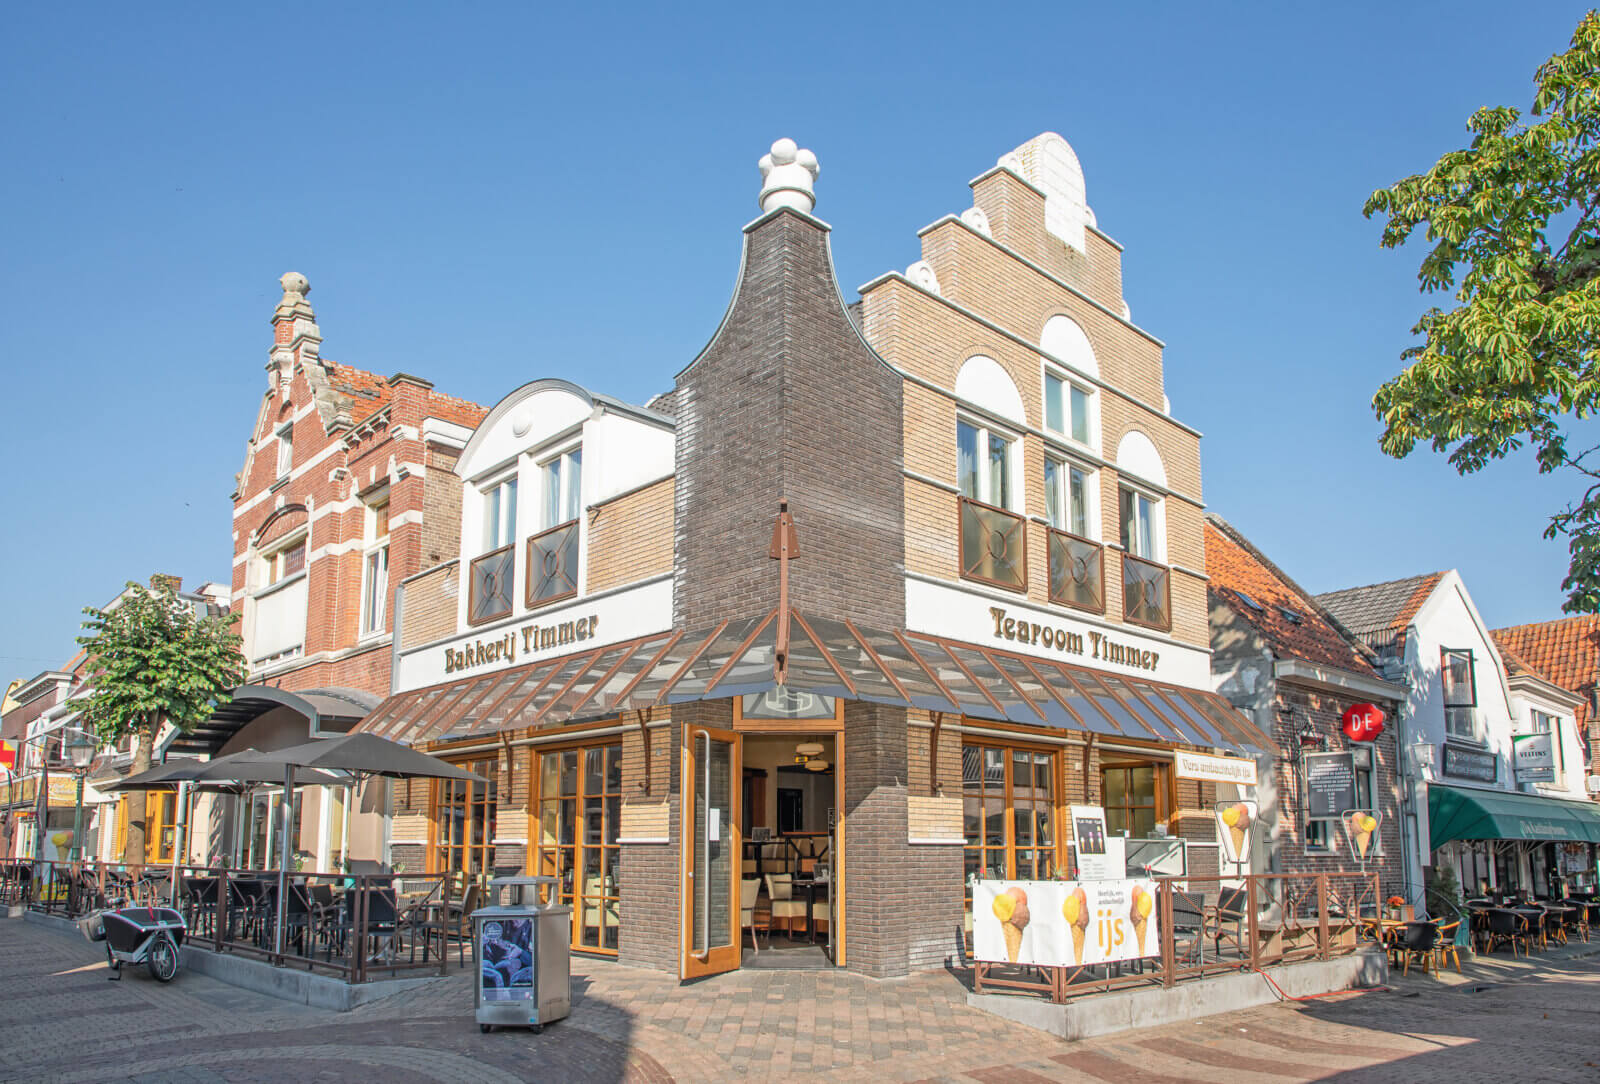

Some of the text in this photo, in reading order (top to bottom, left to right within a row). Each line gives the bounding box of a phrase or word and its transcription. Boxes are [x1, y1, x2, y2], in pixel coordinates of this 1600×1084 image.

[445, 614, 599, 674] Bakkerij Timmer
[989, 606, 1160, 671] Tearoom Timmer
[1097, 909, 1124, 957] ijs
